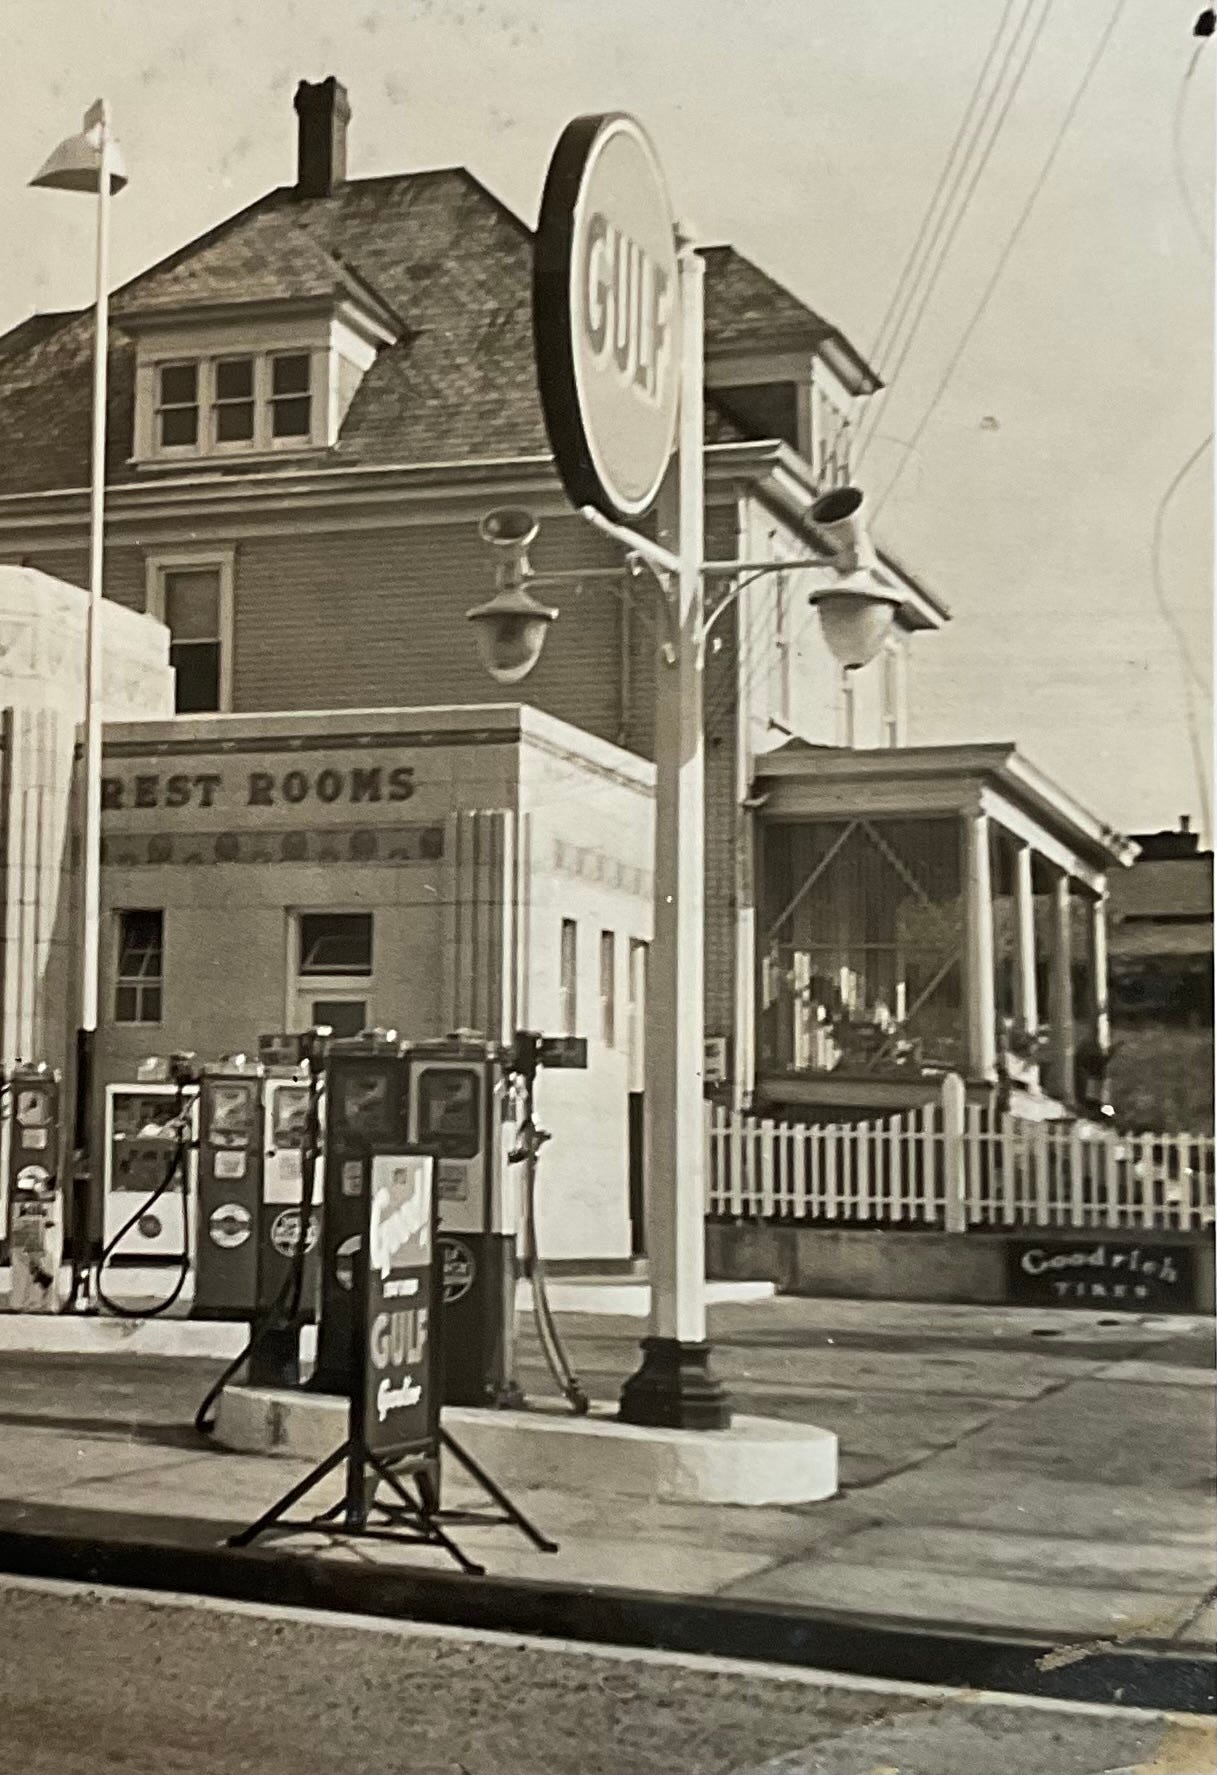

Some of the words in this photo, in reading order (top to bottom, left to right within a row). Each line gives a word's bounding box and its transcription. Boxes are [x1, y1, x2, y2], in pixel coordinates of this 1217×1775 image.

[585, 211, 669, 400] GULF
[101, 773, 222, 811] REST
[247, 766, 415, 807] ROOMS
[370, 1307, 429, 1370] GULF
